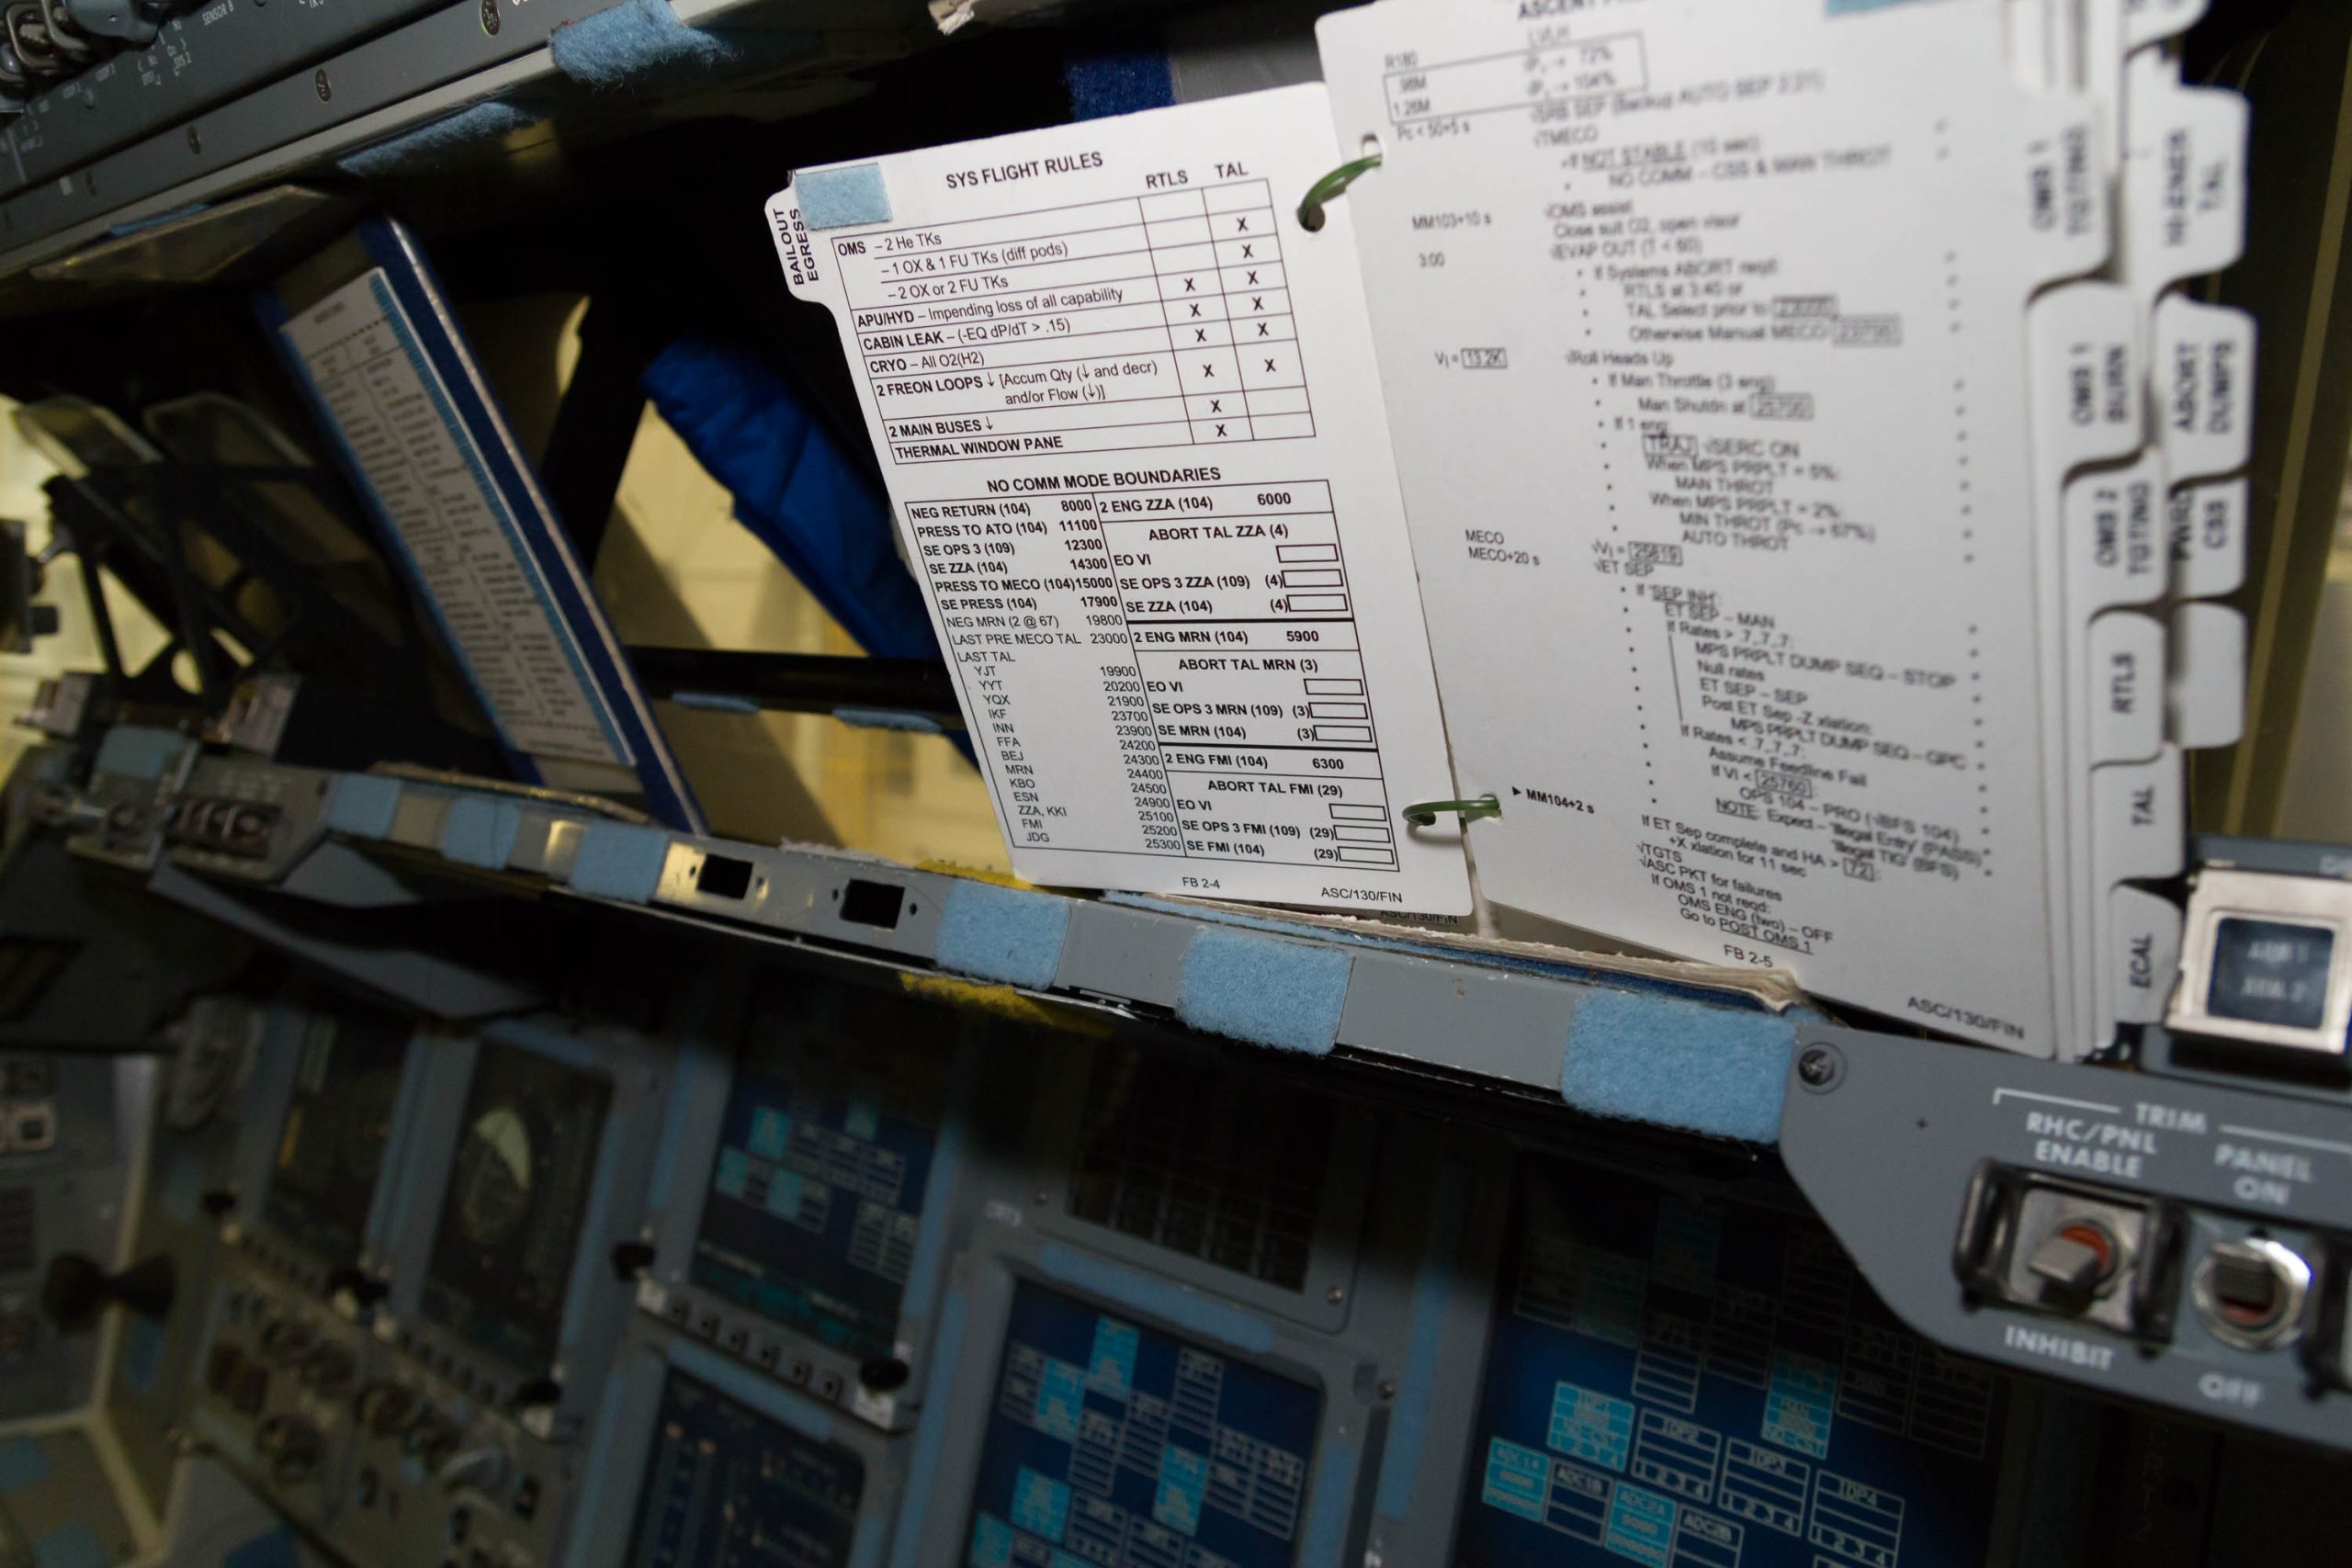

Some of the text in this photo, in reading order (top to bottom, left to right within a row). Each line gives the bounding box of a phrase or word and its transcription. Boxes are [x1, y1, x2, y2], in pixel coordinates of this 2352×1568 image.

[202, 4, 228, 26] SENSOR
[944, 151, 1104, 190] SYS FLIGHT RULES
[1145, 161, 1250, 190] RTLS TAL
[772, 208, 804, 285] BAILOUT
[789, 209, 819, 282] EGRESS
[836, 240, 867, 257] OMS
[883, 237, 895, 252] 2
[894, 235, 915, 251] He
[914, 231, 943, 248] TKs
[891, 261, 900, 276] 1
[901, 257, 925, 275] OX
[924, 256, 937, 273] &
[938, 255, 947, 270] 1
[948, 253, 970, 269] FU
[969, 250, 1000, 266] TKs
[1001, 244, 1027, 265] (diff
[1029, 240, 1069, 263] pods)
[857, 309, 916, 329] APU/HYD
[927, 301, 995, 323] Impending
[994, 299, 1024, 314] loss
[1024, 295, 1039, 310] of
[1041, 293, 1058, 310] all
[1059, 287, 1124, 309] capability
[862, 333, 906, 352] CABIN
[905, 330, 945, 347] LEAK
[956, 325, 989, 345] (-EQ
[989, 321, 1028, 339] dP/dT
[1046, 317, 1071, 334] .15)
[868, 357, 908, 375] CRYO
[921, 355, 938, 370] All
[938, 350, 986, 369] O2(H2)
[888, 418, 983, 439] 2 MAIN BUSES
[894, 434, 1065, 460] THERMAL WINDOW PANE
[986, 466, 1222, 494] NO COMM MODE BOUNDARIES
[910, 498, 1093, 520] NEG RETURN (104) 8000
[1098, 491, 1293, 514] 2 ENG ZZA (104) 6000
[916, 518, 1099, 539] PRESS TO ATO (104) 11100
[1148, 523, 1290, 542] ABORT TAL ZZA (4)
[1464, 528, 1506, 547] MECO
[1467, 545, 1531, 566] MECO+20
[933, 576, 1114, 593] PRESS TO MECO (104) 15000
[950, 632, 1129, 647] LAST PRE MECO TAL 23000
[972, 664, 1137, 678] YJT 19900
[2111, 653, 2136, 714] RTLS
[1008, 777, 1169, 795] KBO 24500
[1207, 779, 1344, 799] ABORT TAL FMI (29)
[1012, 790, 1171, 810] ESN 24900
[1525, 787, 1585, 813] MM104+2
[2132, 787, 2154, 825] TAL
[1016, 804, 1175, 824] ZZA, KKI 25100
[1181, 875, 1221, 890] FB 2-4
[1320, 886, 1404, 904] ASC/130/FIN
[1650, 873, 1661, 886] If
[1661, 875, 1697, 896] OMS
[1711, 890, 1734, 906] not
[1678, 864, 1708, 884] PKT
[1710, 872, 1730, 889] for
[1731, 877, 1784, 903] failures
[1679, 906, 1702, 923] Go
[1701, 913, 1717, 927] to
[1718, 916, 1760, 939] POST
[1761, 928, 1800, 950] OMS
[1723, 943, 1774, 969] FB 2-5
[2130, 935, 2153, 989] ECAL
[1906, 995, 2026, 1041] ASC/130/FIN
[2135, 1102, 2207, 1133] TRIM
[2027, 1112, 2158, 1154] RHC/PNL
[2035, 1140, 2142, 1178] ENABLE
[2215, 1145, 2312, 1184] PANEL
[2234, 1178, 2289, 1205] ON
[2004, 1325, 2115, 1369] INHIBIT
[2199, 1373, 2262, 1406] OFF
